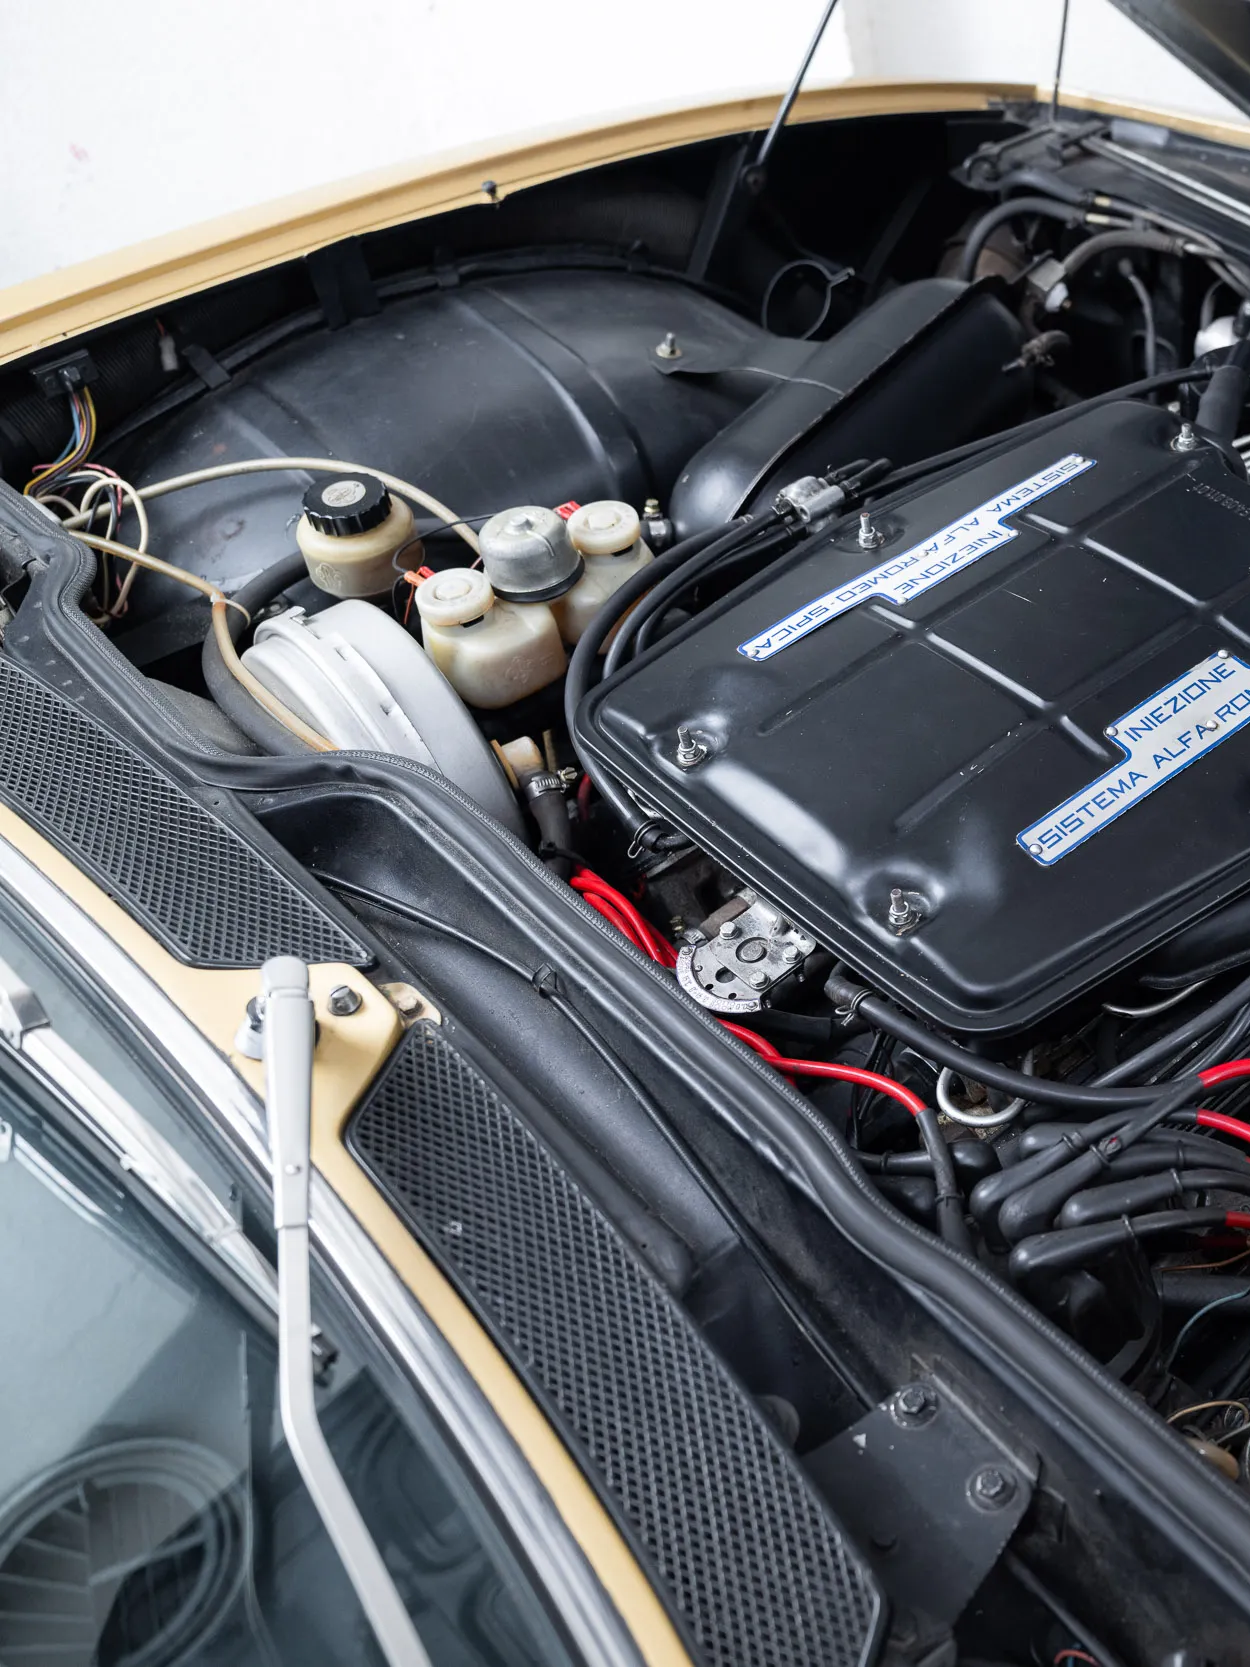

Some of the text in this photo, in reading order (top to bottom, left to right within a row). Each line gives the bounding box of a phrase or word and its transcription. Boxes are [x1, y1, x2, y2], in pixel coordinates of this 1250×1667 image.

[987, 462, 1078, 513] SISTEMA
[894, 530, 1003, 594] INIEZIONE
[928, 516, 980, 553] ALFA
[1123, 663, 1236, 743] INIEZIONE
[1037, 771, 1149, 849] SISTEMA
[1152, 724, 1210, 769] ALFA
